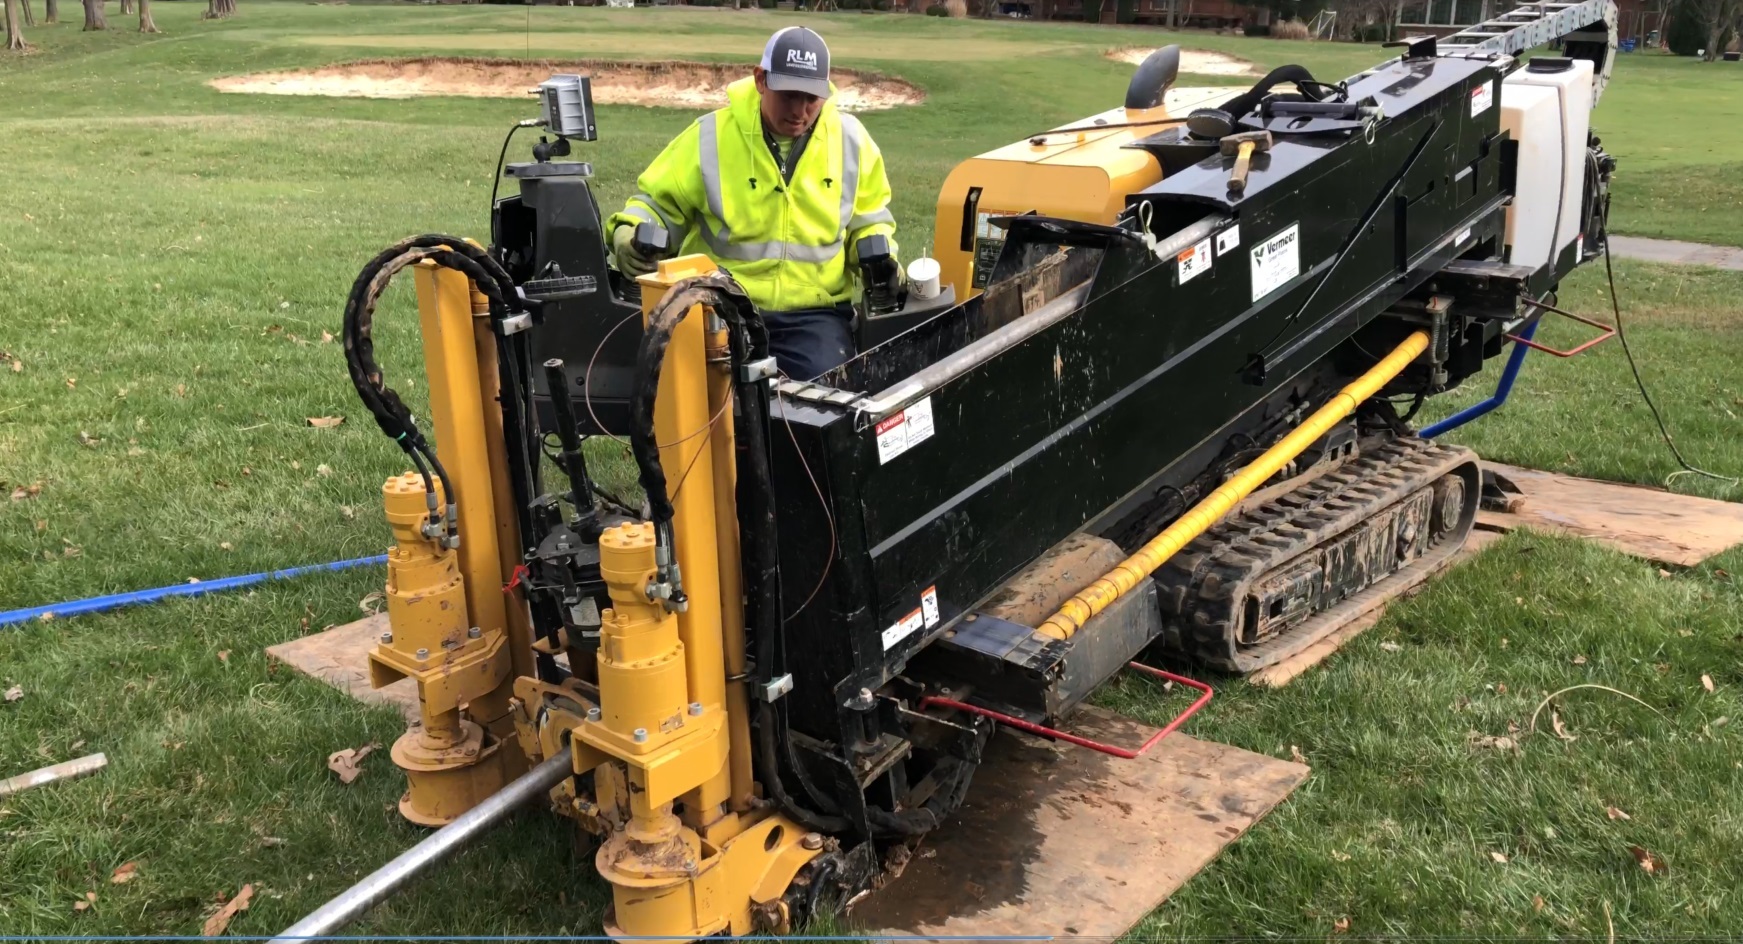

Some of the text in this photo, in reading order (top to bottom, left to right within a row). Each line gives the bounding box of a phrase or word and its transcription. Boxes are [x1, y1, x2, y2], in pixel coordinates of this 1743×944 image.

[787, 49, 817, 66] RLM
[1267, 232, 1296, 255] Vermeer
[882, 413, 904, 430] DANGER
